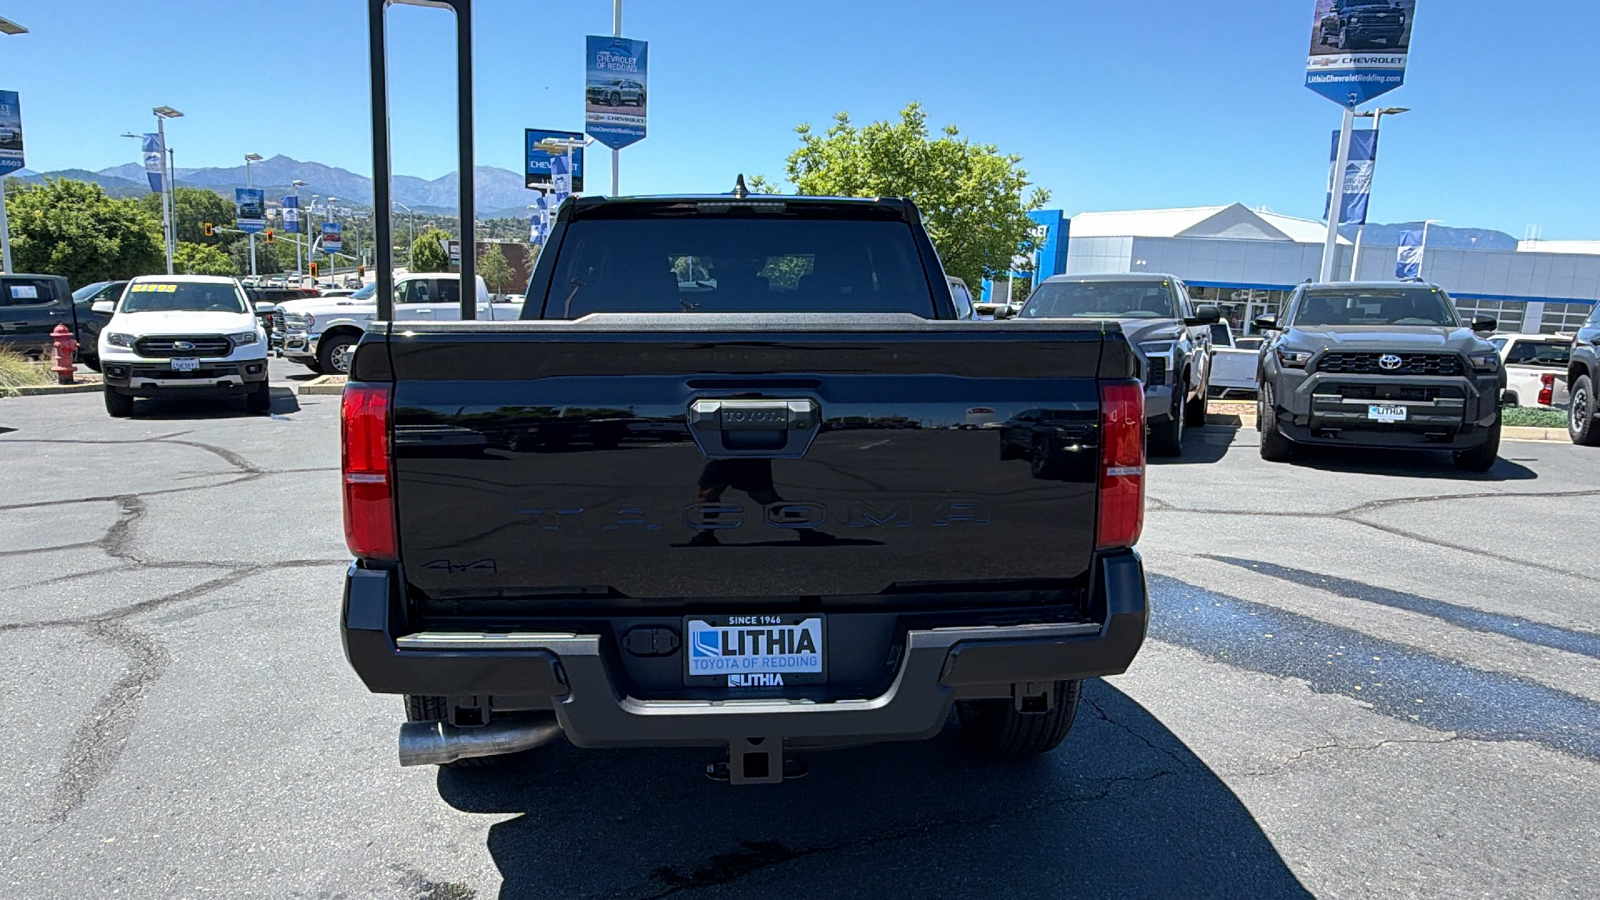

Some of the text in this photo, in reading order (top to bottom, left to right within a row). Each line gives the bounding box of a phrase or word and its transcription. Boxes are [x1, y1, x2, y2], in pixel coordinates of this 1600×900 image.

[596, 54, 638, 65] CHEVROLET
[596, 61, 638, 72] OF REDDING
[607, 115, 644, 123] CHEVROLET
[724, 411, 786, 421] TOYOTA
[1377, 407, 1404, 415] LITHIA
[514, 501, 990, 530] TACOMA
[728, 615, 781, 625] SINCE 1946
[721, 628, 817, 656] LITHIA
[692, 656, 818, 670] TOYOTA OF REDDING
[740, 673, 784, 686] LITHIA
